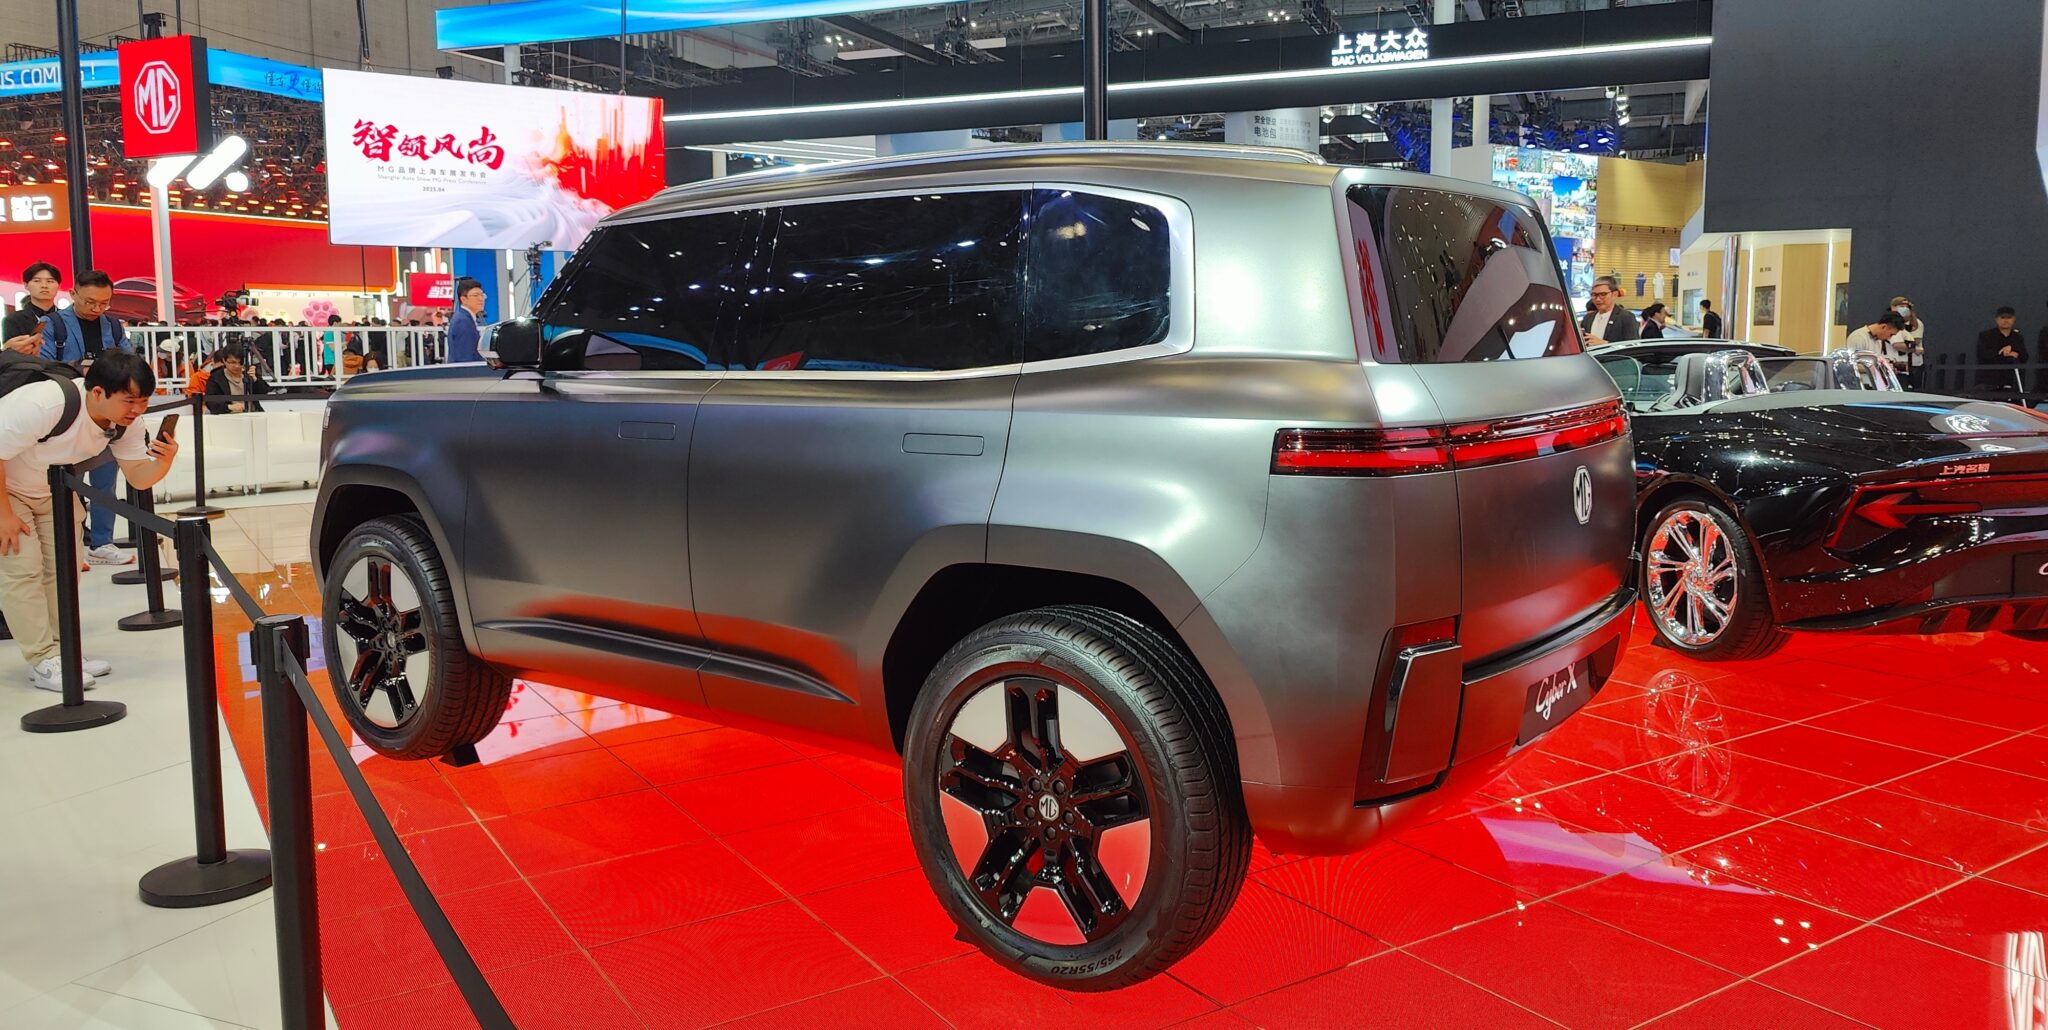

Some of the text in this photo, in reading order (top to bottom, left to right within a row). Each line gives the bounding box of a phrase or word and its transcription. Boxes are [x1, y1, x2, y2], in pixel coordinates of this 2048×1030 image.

[1331, 28, 1428, 55] 上汽大众
[1331, 49, 1428, 67] SAIC VOLKSWAGEN
[137, 65, 179, 130] MG
[353, 119, 504, 170] 智领风尚
[1574, 469, 1591, 521] MG
[1536, 662, 1577, 720] Cyber X
[1040, 797, 1058, 819] MG
[1051, 949, 1122, 975] 265/55R20
